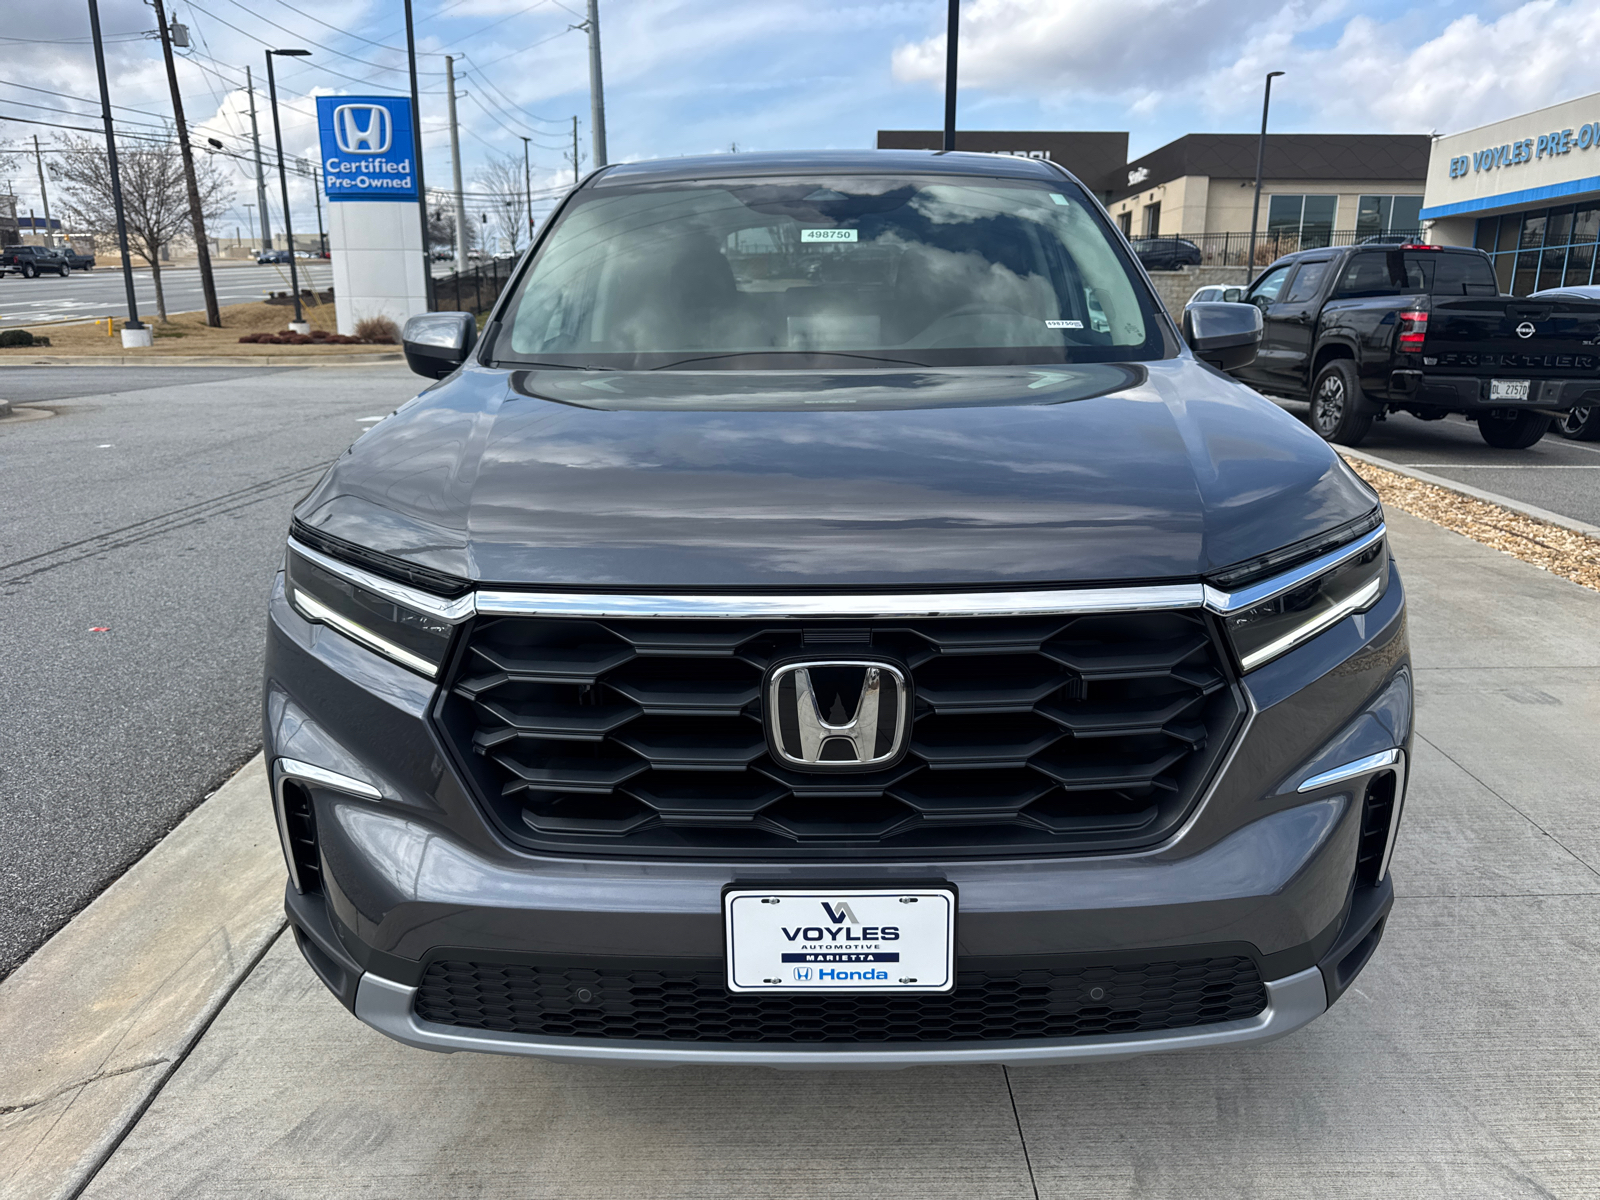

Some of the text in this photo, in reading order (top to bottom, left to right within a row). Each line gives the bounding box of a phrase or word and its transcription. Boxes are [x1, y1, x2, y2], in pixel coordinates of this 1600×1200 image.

[1449, 154, 1471, 179] ED
[1473, 138, 1533, 173] VOYLES
[326, 158, 411, 174] Certified
[326, 175, 412, 188] Pre-Owned
[807, 230, 851, 239] 498750
[1439, 354, 1593, 368] FRONTIER
[781, 926, 900, 941] VOYLES
[819, 968, 888, 980] Honda
